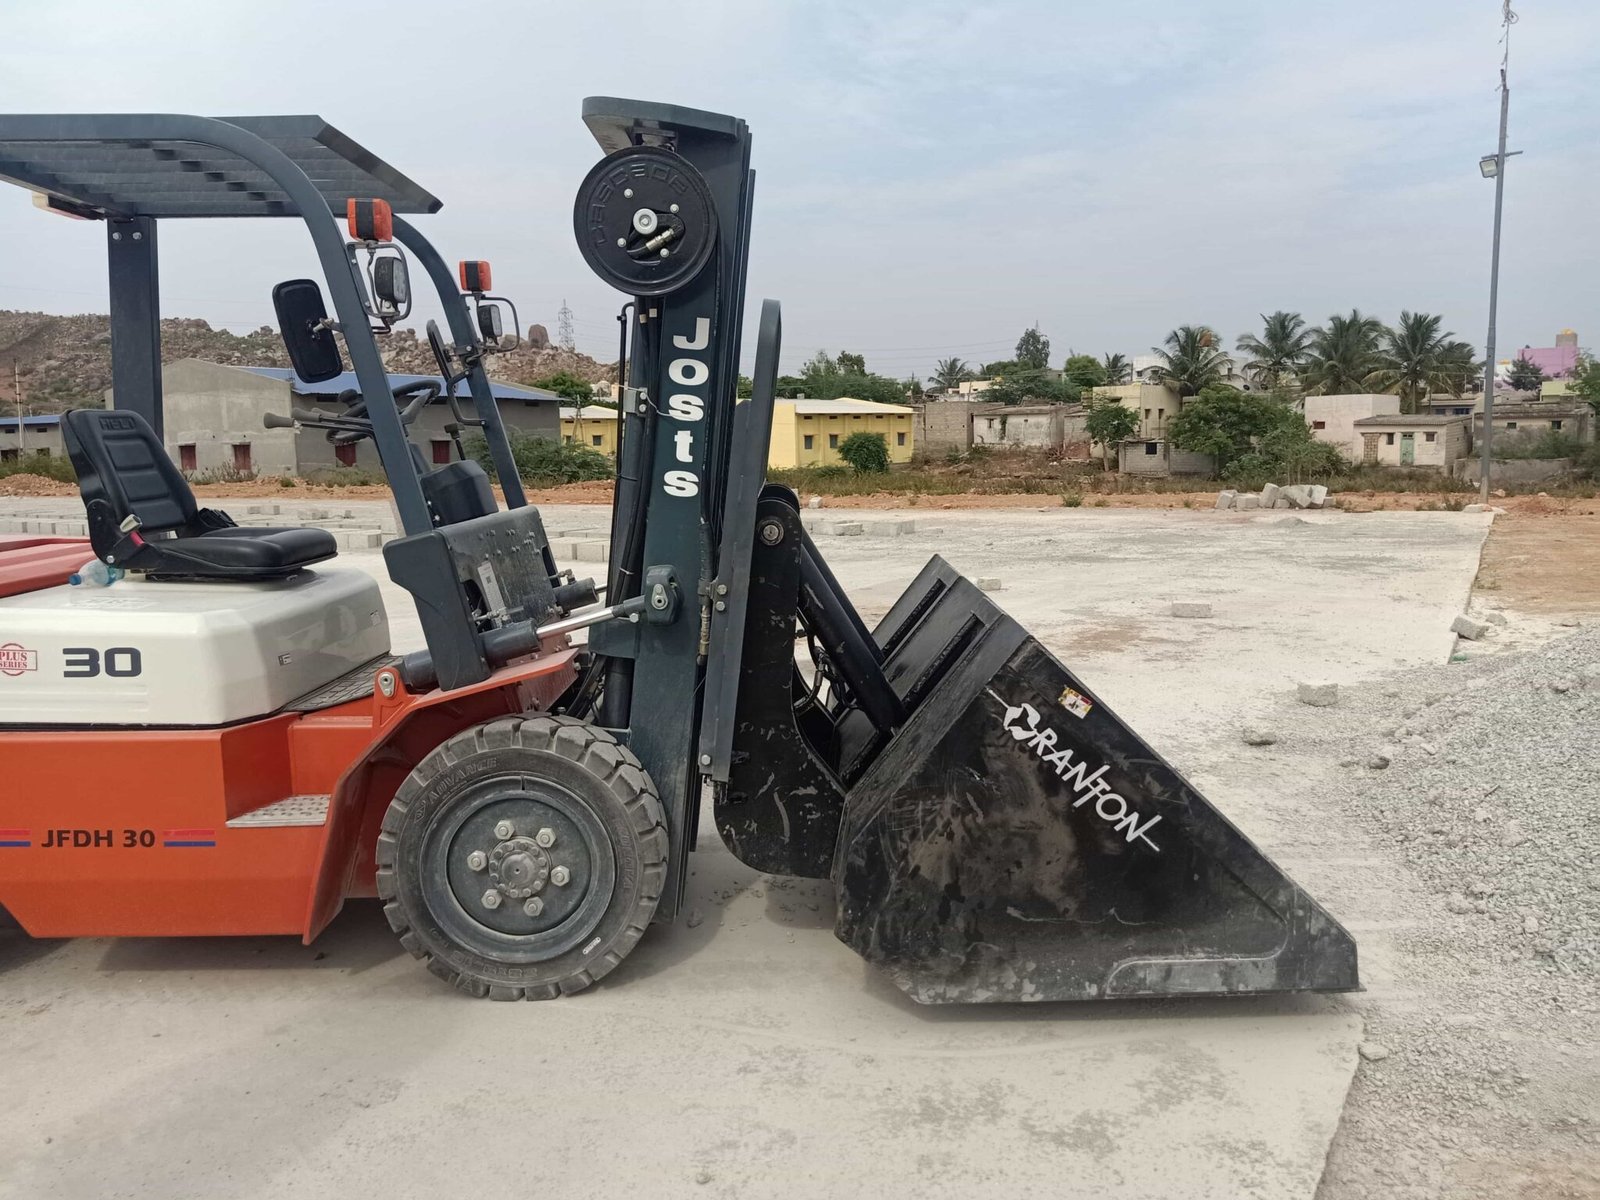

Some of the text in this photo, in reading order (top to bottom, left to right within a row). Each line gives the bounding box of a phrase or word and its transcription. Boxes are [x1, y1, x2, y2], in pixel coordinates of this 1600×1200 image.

[0, 651, 28, 662] PLUS
[62, 646, 142, 678] 30
[41, 829, 155, 848] JFDH 30
